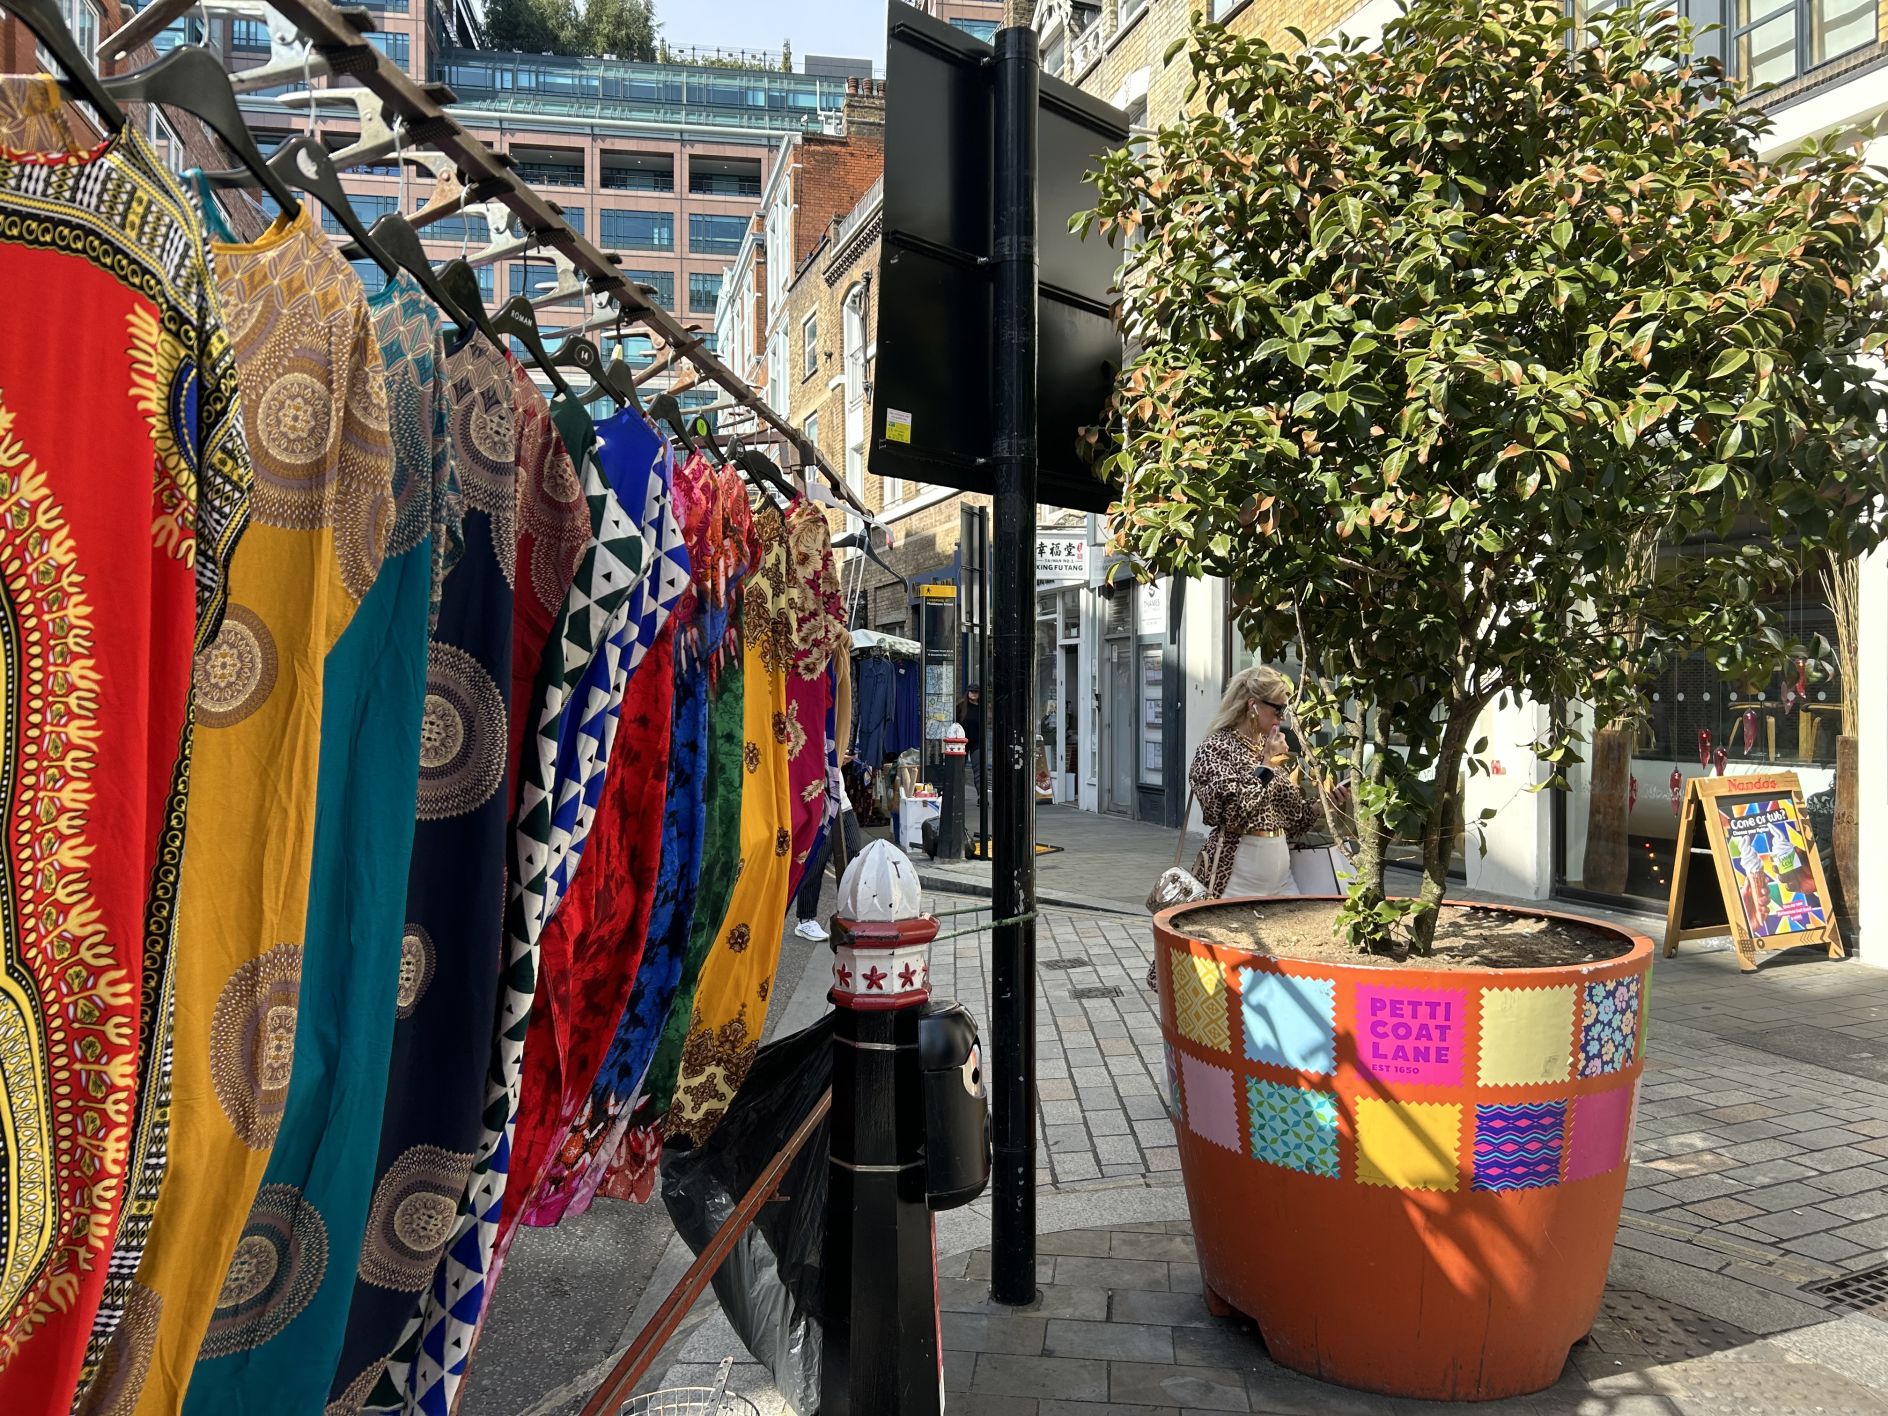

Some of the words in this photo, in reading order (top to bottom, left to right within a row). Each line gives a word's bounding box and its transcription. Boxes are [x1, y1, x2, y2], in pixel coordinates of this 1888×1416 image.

[511, 309, 533, 327] ROMAN
[580, 350, 589, 361] 14
[1036, 541, 1076, 558] 幸福堂
[1727, 777, 1777, 792] Nando's
[1731, 817, 1755, 830] Cone
[1755, 814, 1767, 824] or
[1766, 809, 1786, 823] tub?
[1370, 996, 1452, 1022] PETTI
[1369, 1019, 1452, 1042] COAT
[1371, 1041, 1450, 1064] LANE
[1371, 1064, 1391, 1072] EST
[1394, 1066, 1420, 1074] 1650
